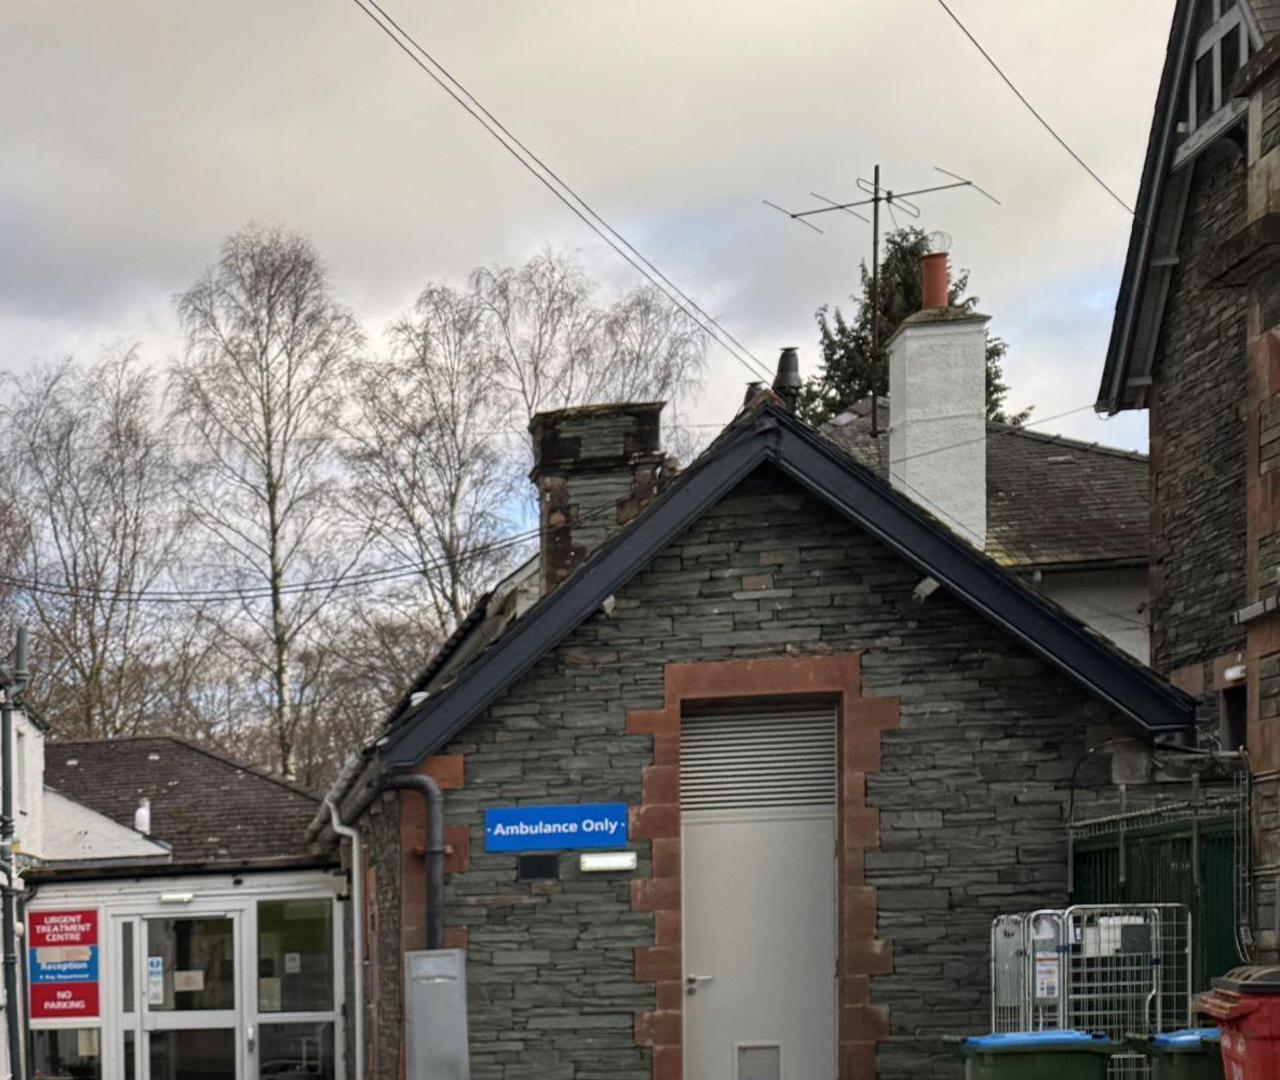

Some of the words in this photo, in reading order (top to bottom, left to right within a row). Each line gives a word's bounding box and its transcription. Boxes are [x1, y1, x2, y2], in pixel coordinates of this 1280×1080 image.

[494, 820, 578, 836] Ambulance
[582, 818, 618, 834] Only
[44, 914, 82, 924] URGENT
[36, 923, 91, 934] TREATMENT
[46, 933, 81, 942] CENTRE
[56, 990, 72, 999] NO
[44, 1000, 86, 1010] PARKING
